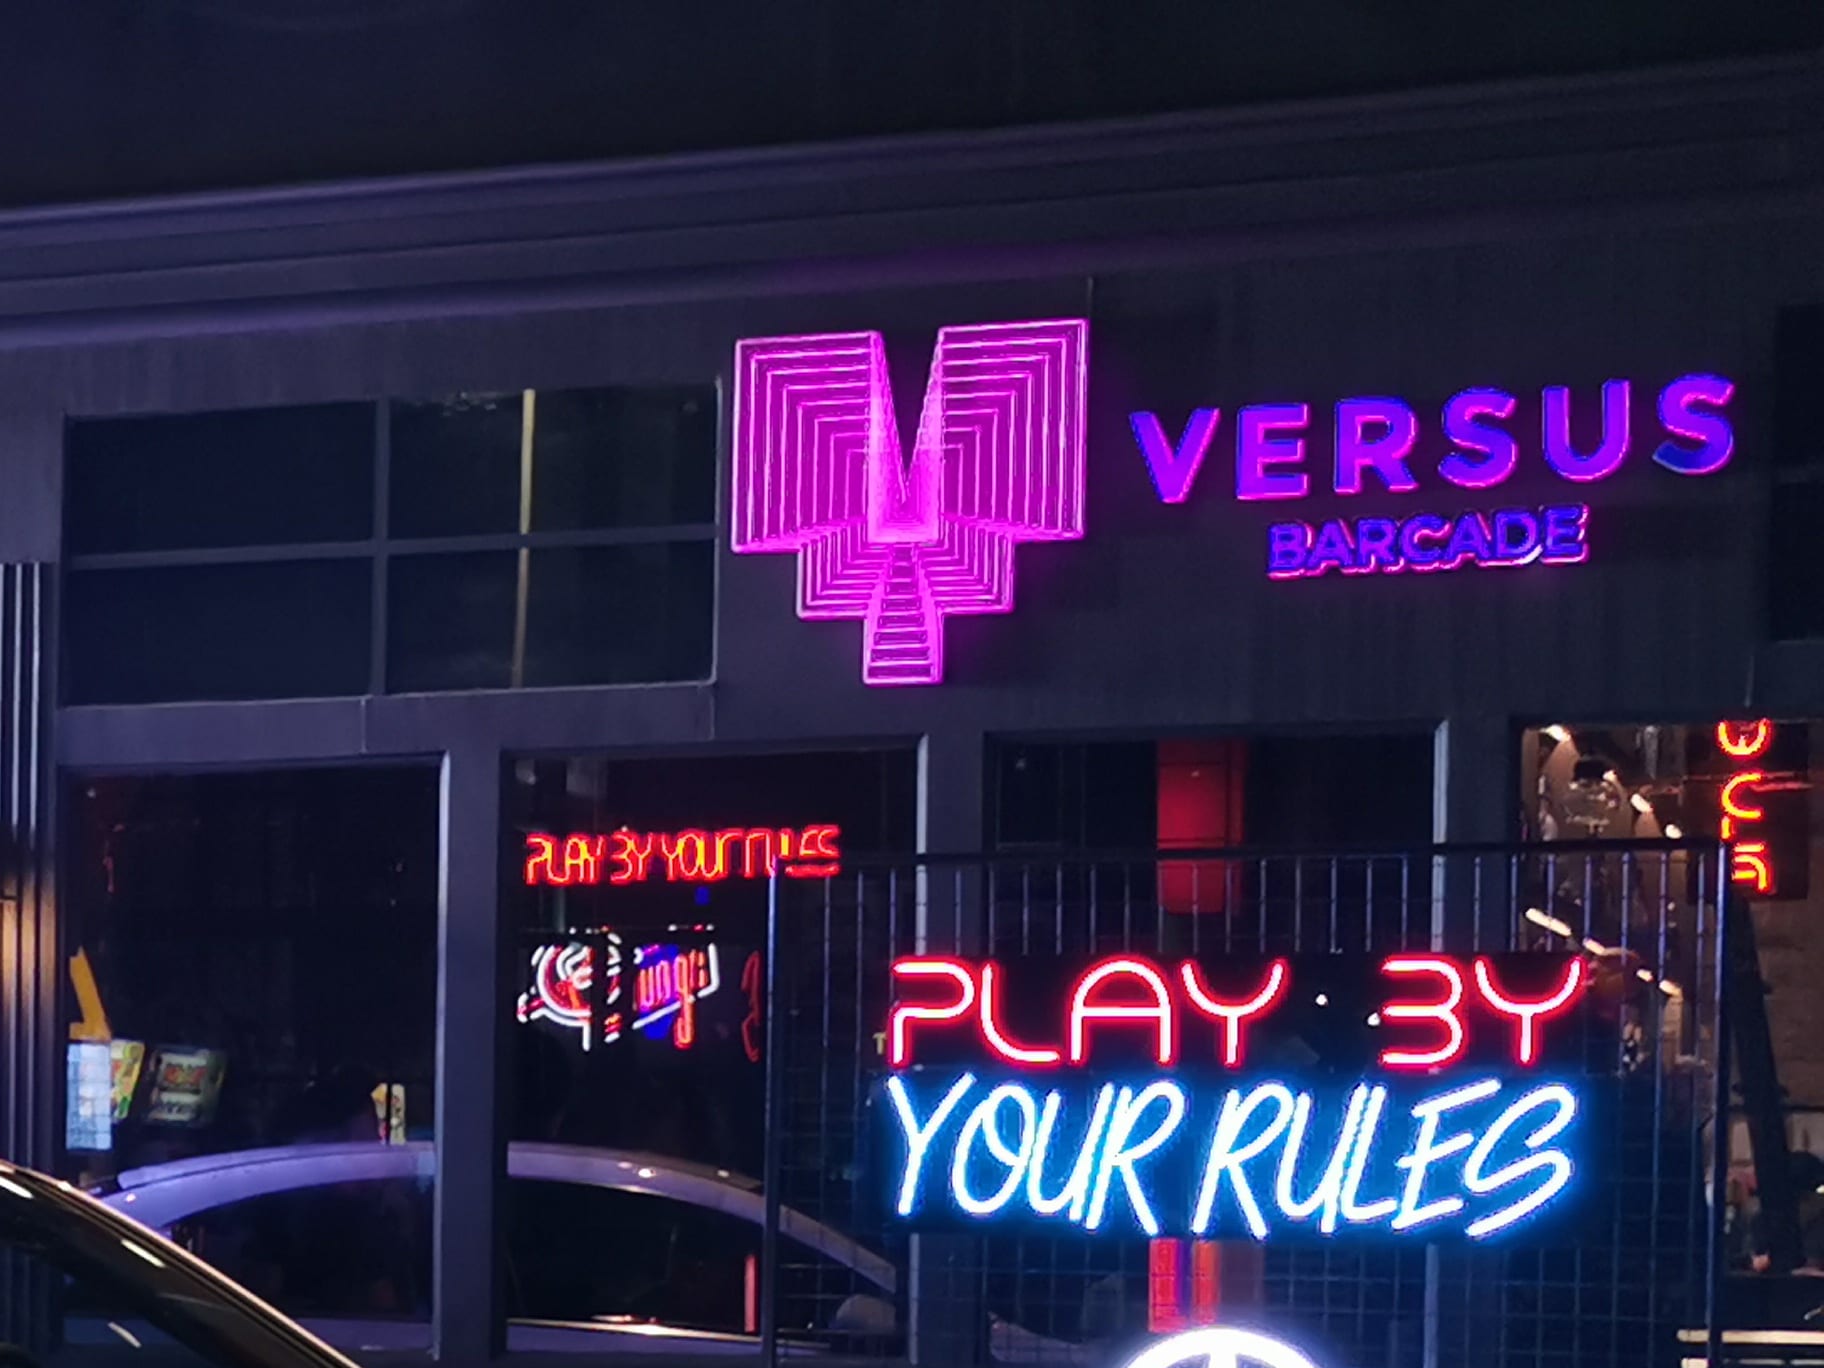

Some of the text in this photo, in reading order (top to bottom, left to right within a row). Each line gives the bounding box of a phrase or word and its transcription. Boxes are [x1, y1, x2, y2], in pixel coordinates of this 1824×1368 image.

[1128, 373, 1737, 504] VERSUS
[1266, 504, 1591, 580] BARCADE
[888, 957, 1583, 1065] PLAY BY
[885, 1070, 1579, 1240] YOUR RULES
